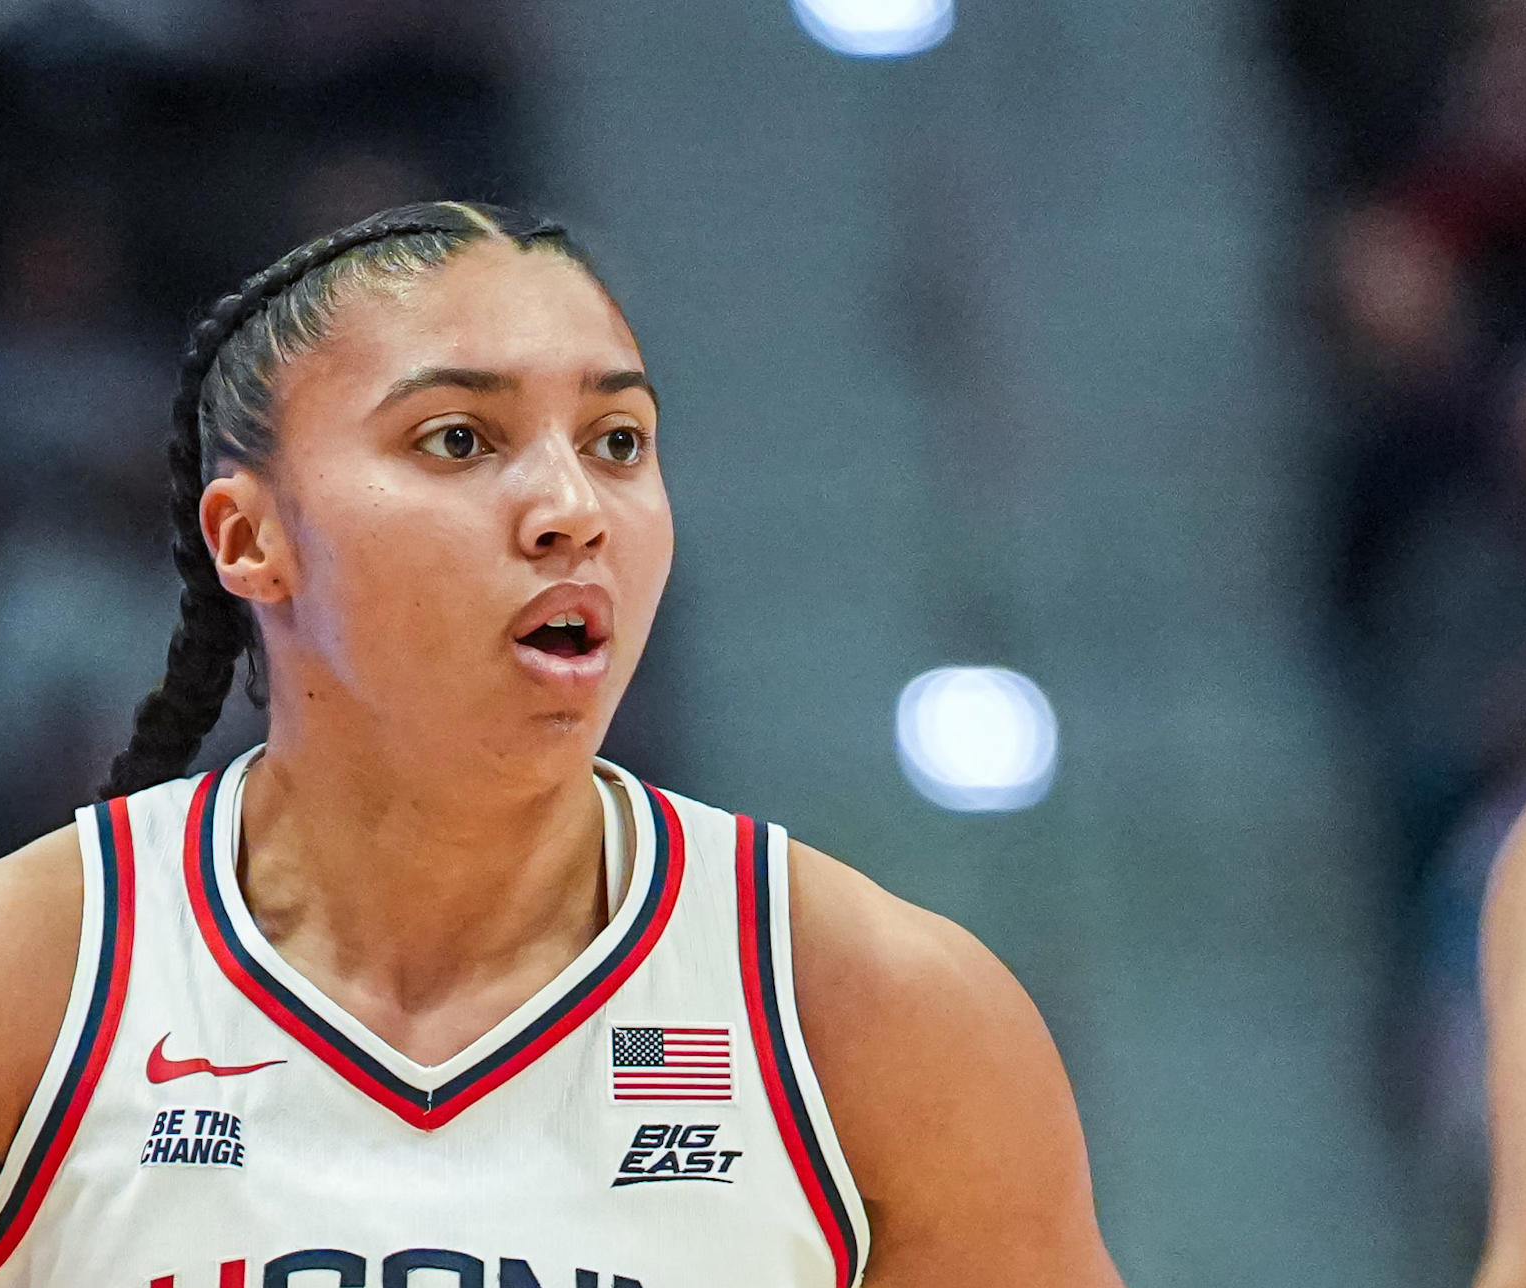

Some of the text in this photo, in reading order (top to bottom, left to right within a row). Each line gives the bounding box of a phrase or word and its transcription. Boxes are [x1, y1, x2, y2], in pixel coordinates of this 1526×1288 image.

[151, 1109, 242, 1141] BE THE
[630, 1123, 721, 1149] BIG
[140, 1137, 246, 1167] CHANGE
[618, 1150, 743, 1174] EAST
